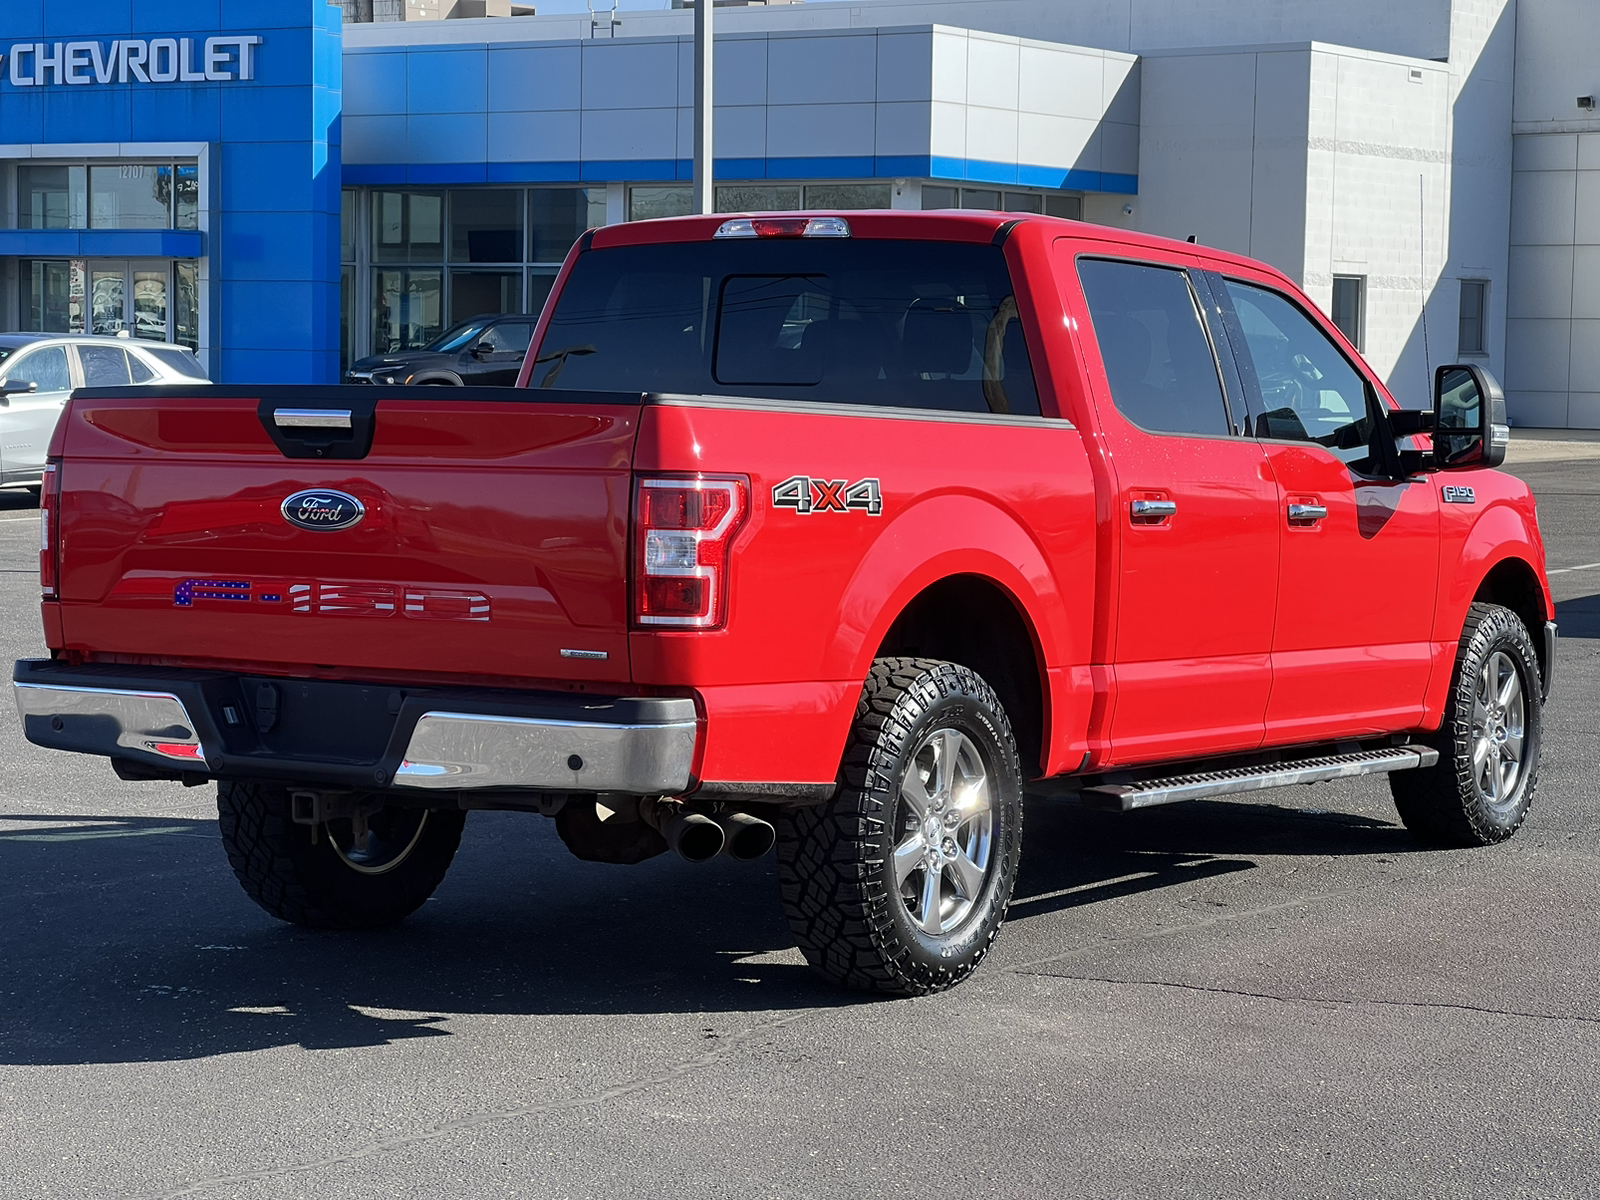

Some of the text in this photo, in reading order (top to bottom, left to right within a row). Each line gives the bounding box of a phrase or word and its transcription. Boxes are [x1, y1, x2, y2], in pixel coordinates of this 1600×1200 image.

[10, 36, 263, 86] CHEVROLET
[119, 165, 144, 179] 12707
[298, 497, 342, 521] Ford
